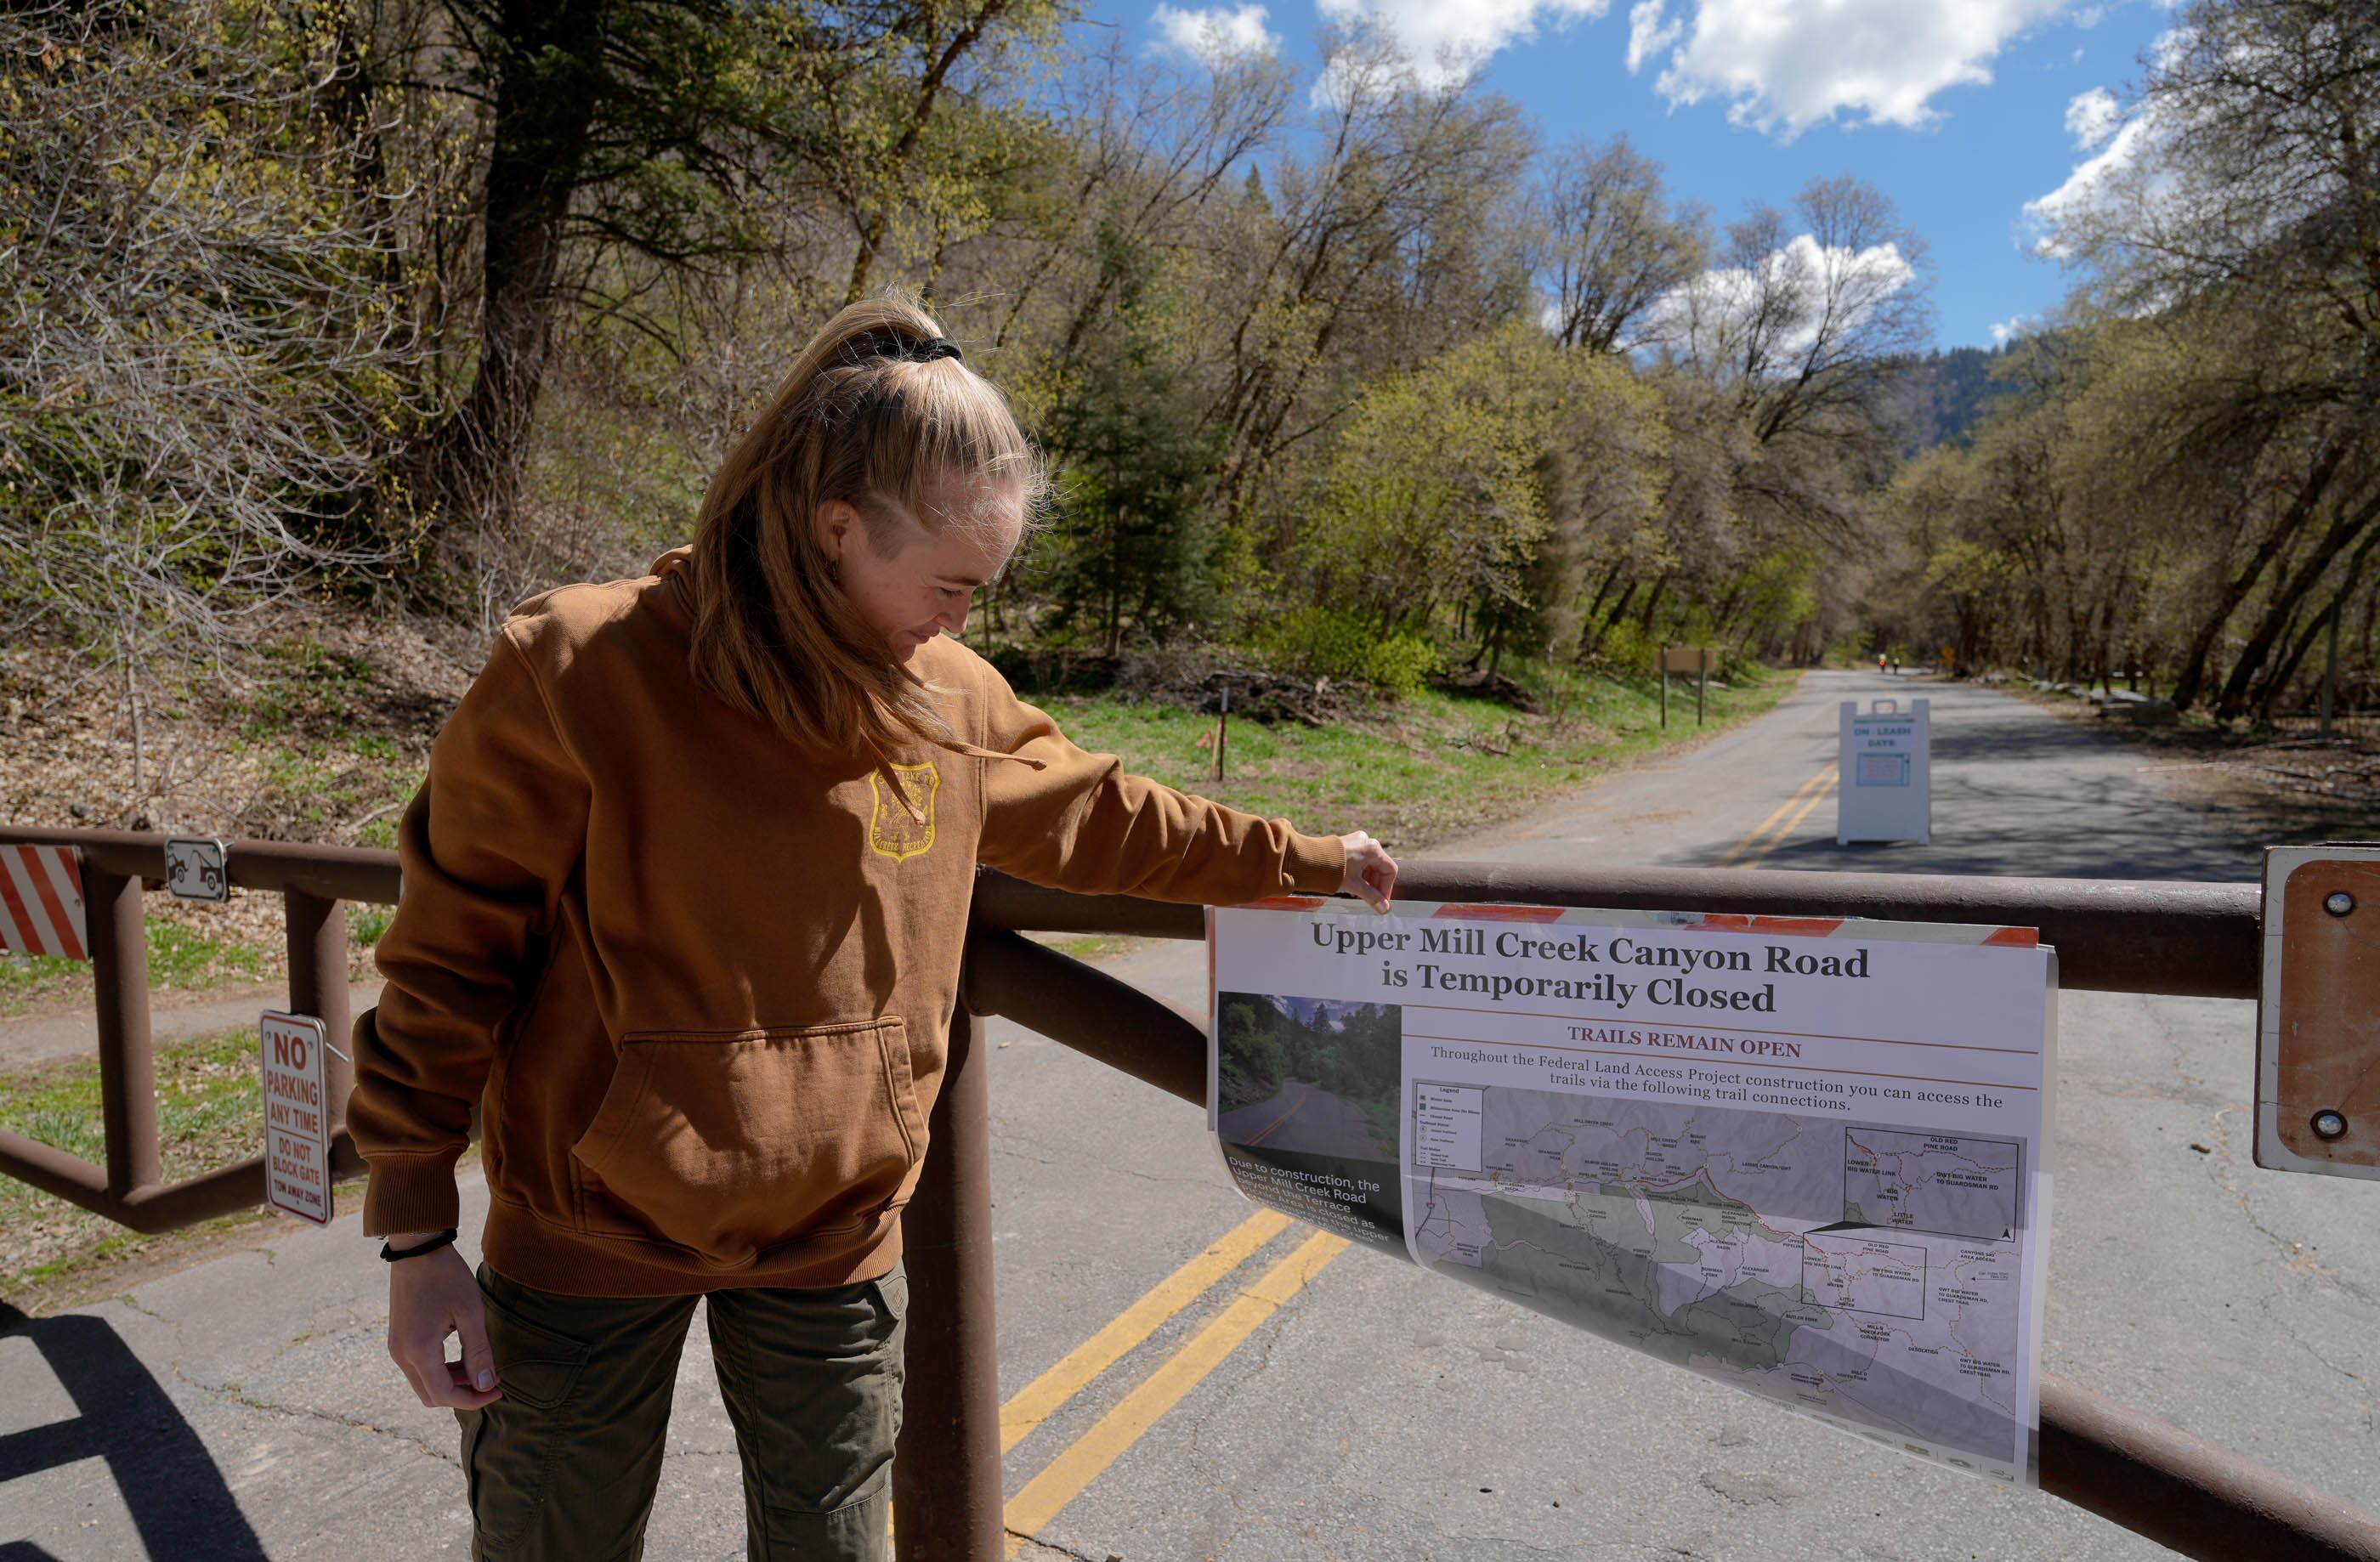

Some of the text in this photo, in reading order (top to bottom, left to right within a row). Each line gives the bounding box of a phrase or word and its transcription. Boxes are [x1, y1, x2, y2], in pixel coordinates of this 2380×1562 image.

[1312, 922, 1871, 978] Upper Mill Creek Canyon Road
[1382, 961, 1776, 1012] is Temporarily Closed
[273, 1033, 306, 1071] NO
[1567, 1027, 1802, 1058] TRAILS REMAIN OPEN
[267, 1070, 318, 1106] PARKING
[1431, 1045, 2003, 1108] Throughout the Federal Land Access Project construction you can access the
[1550, 1072, 1851, 1112] trails via the following trail connections.
[270, 1102, 319, 1134] ANY TIME
[279, 1137, 312, 1163] DO NOT
[273, 1156, 320, 1186] BLOCK GATE
[1229, 1157, 1380, 1192] Due to construction, the
[1233, 1168, 1367, 1204] Upper Mill Creek Road
[1946, 1180, 1987, 1190] GUARDSMAN
[274, 1180, 321, 1208] TOW AWAY ZONE
[1237, 1176, 1351, 1213] beyond the Terrace
[1318, 1208, 1358, 1225] closed
[1361, 1220, 1375, 1229] as
